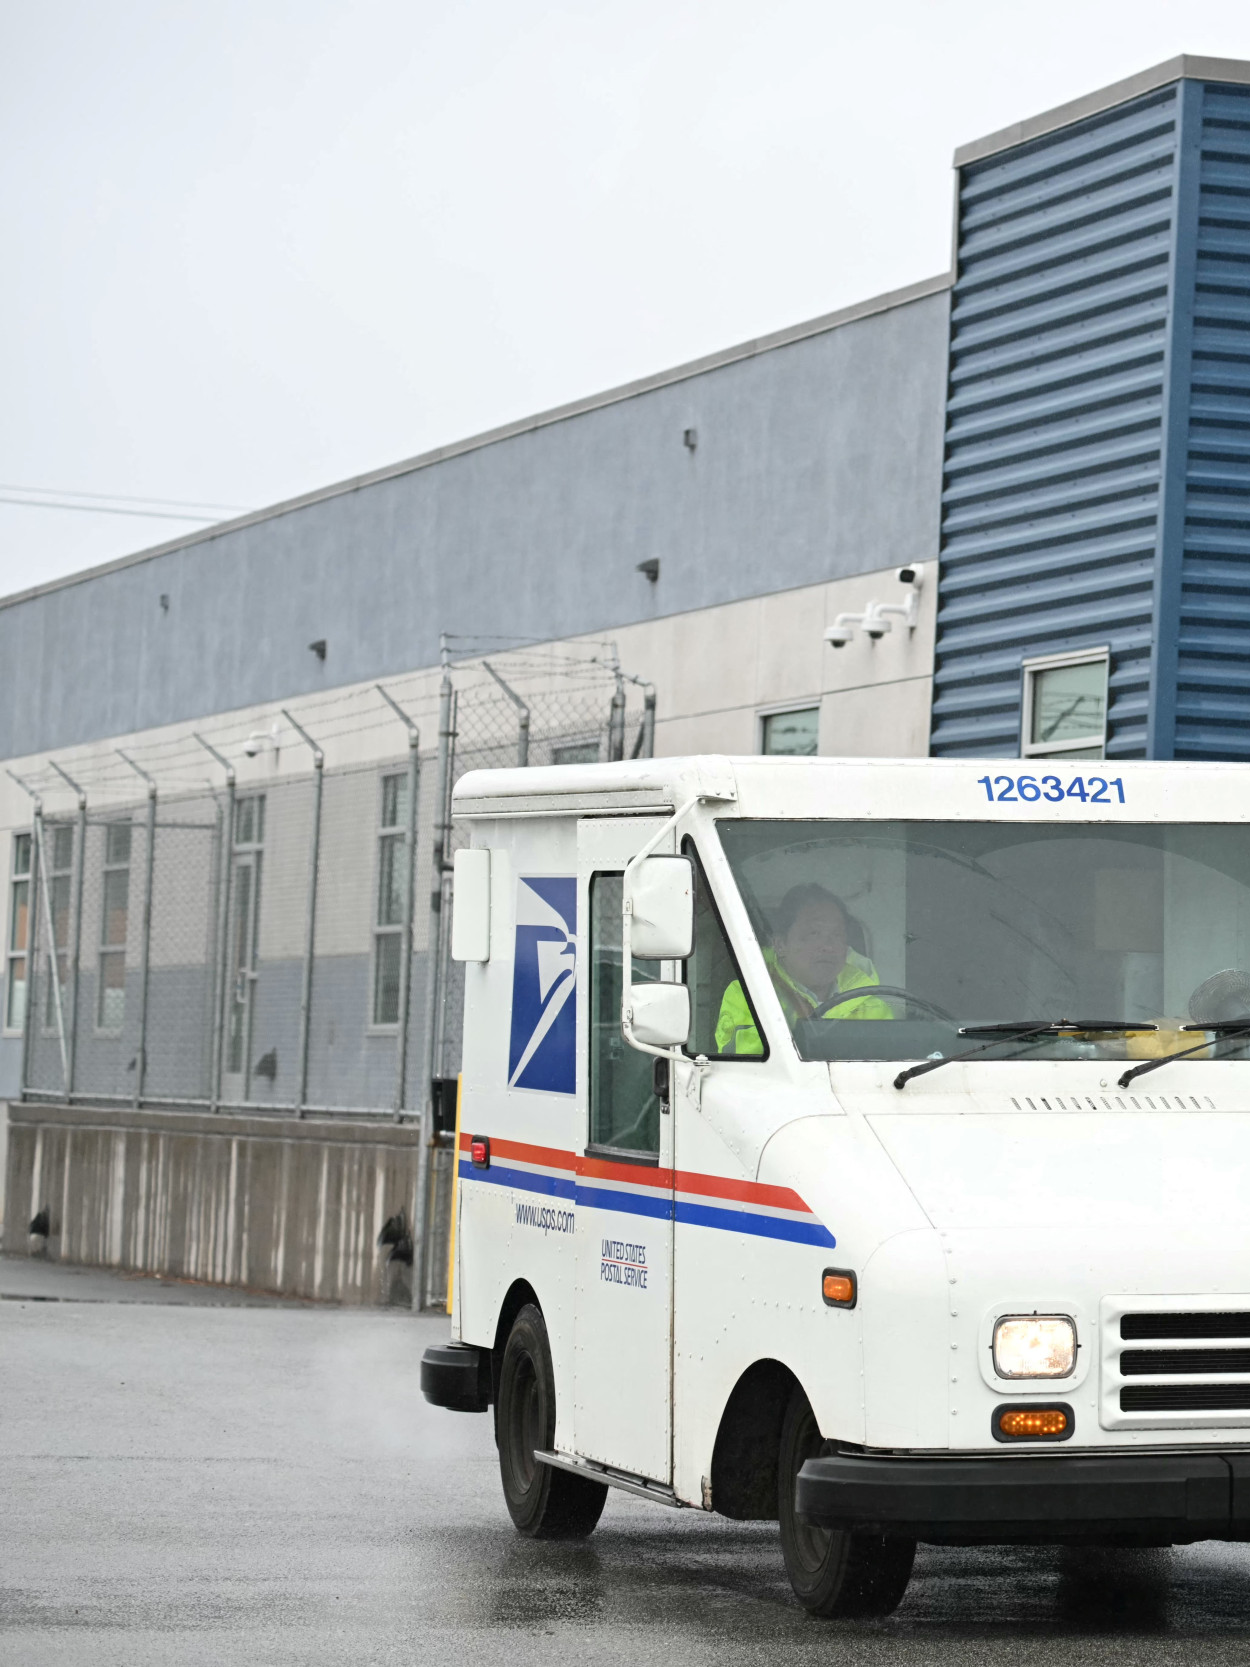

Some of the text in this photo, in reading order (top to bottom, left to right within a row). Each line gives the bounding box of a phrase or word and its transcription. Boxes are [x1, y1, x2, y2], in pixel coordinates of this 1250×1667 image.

[977, 775, 1126, 803] 1263421
[515, 1203, 575, 1237] www.usps.com
[601, 1239, 646, 1264] UNITED STATES
[600, 1262, 648, 1289] POSTAL SERVICE
